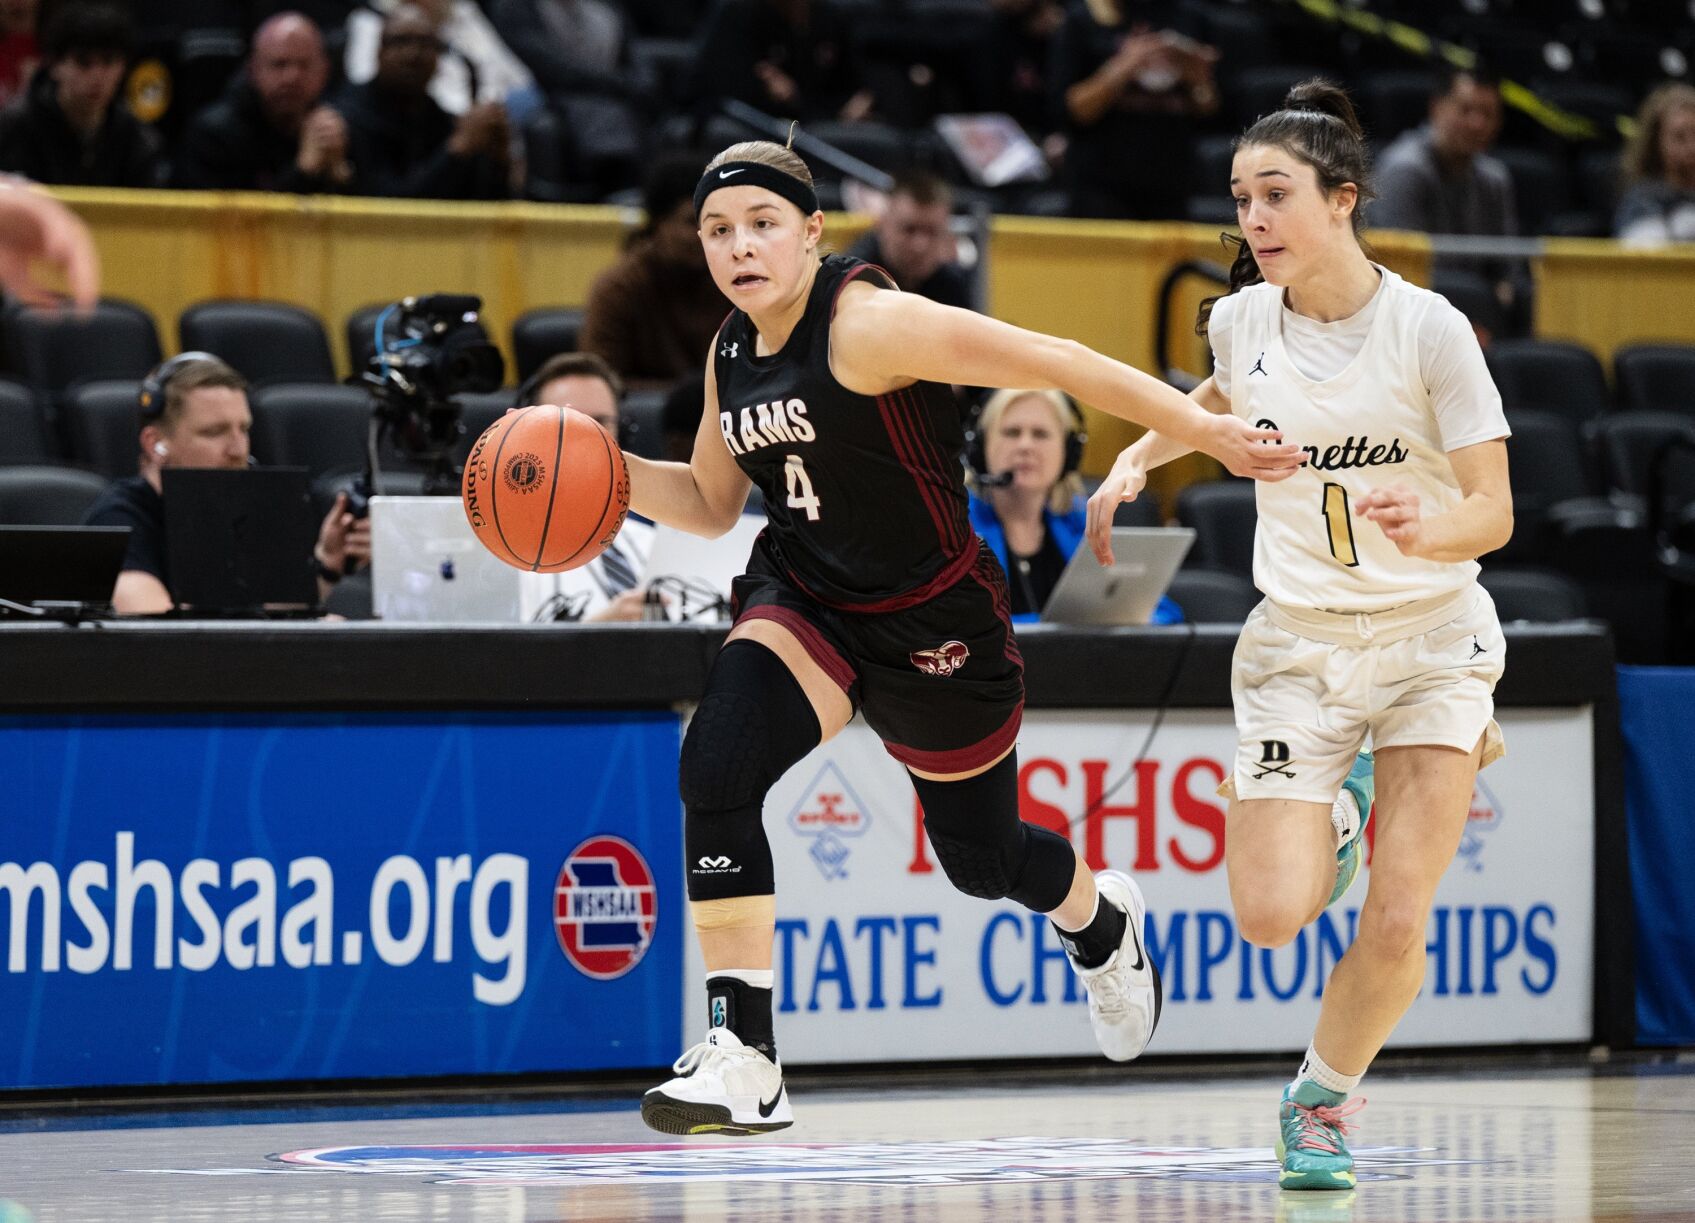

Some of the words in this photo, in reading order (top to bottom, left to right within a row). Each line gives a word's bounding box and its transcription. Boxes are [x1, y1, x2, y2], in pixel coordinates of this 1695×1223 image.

[720, 398, 816, 456] RAMS
[1255, 418, 1409, 471] nettes
[525, 452, 543, 466] 2025
[784, 454, 821, 520] 4
[1322, 482, 1360, 567] 1
[1260, 739, 1290, 763] D
[0, 831, 529, 1006] mshsaa.org
[573, 891, 638, 918] MSHSAA
[774, 914, 943, 1013] TATE
[978, 903, 1558, 1007] CHMPIONHIPS
